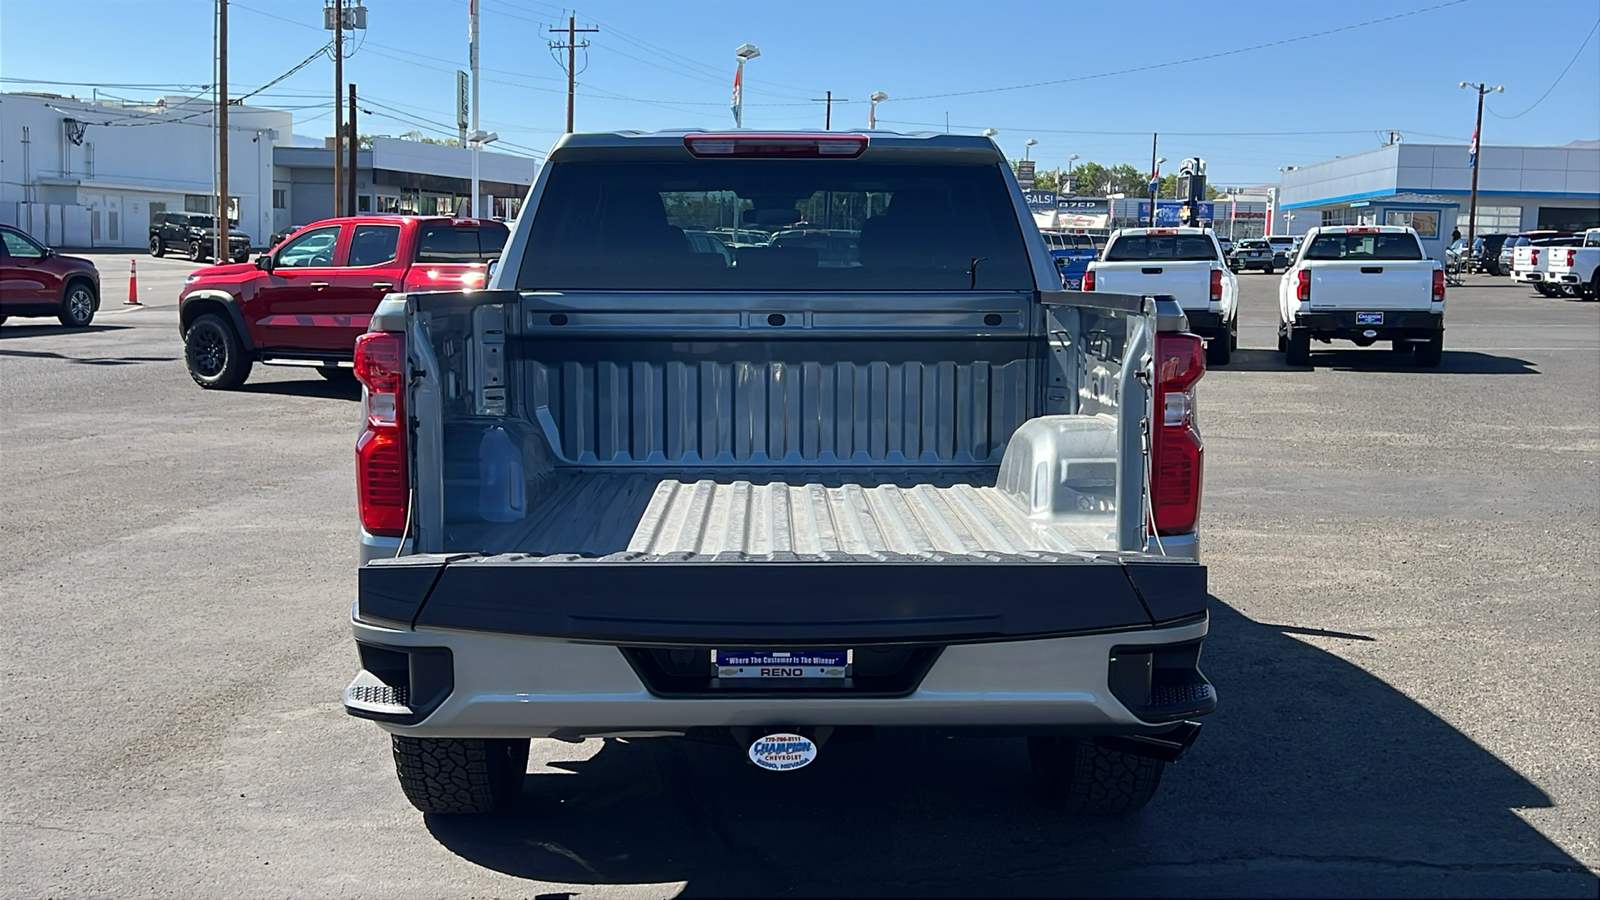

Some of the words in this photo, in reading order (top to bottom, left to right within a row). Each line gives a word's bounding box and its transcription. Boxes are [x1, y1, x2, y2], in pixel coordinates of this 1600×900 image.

[1025, 195, 1053, 204] SALS!
[760, 668, 803, 677] RENO
[754, 742, 812, 755] CHAMPION
[781, 757, 811, 769] NEVADA
